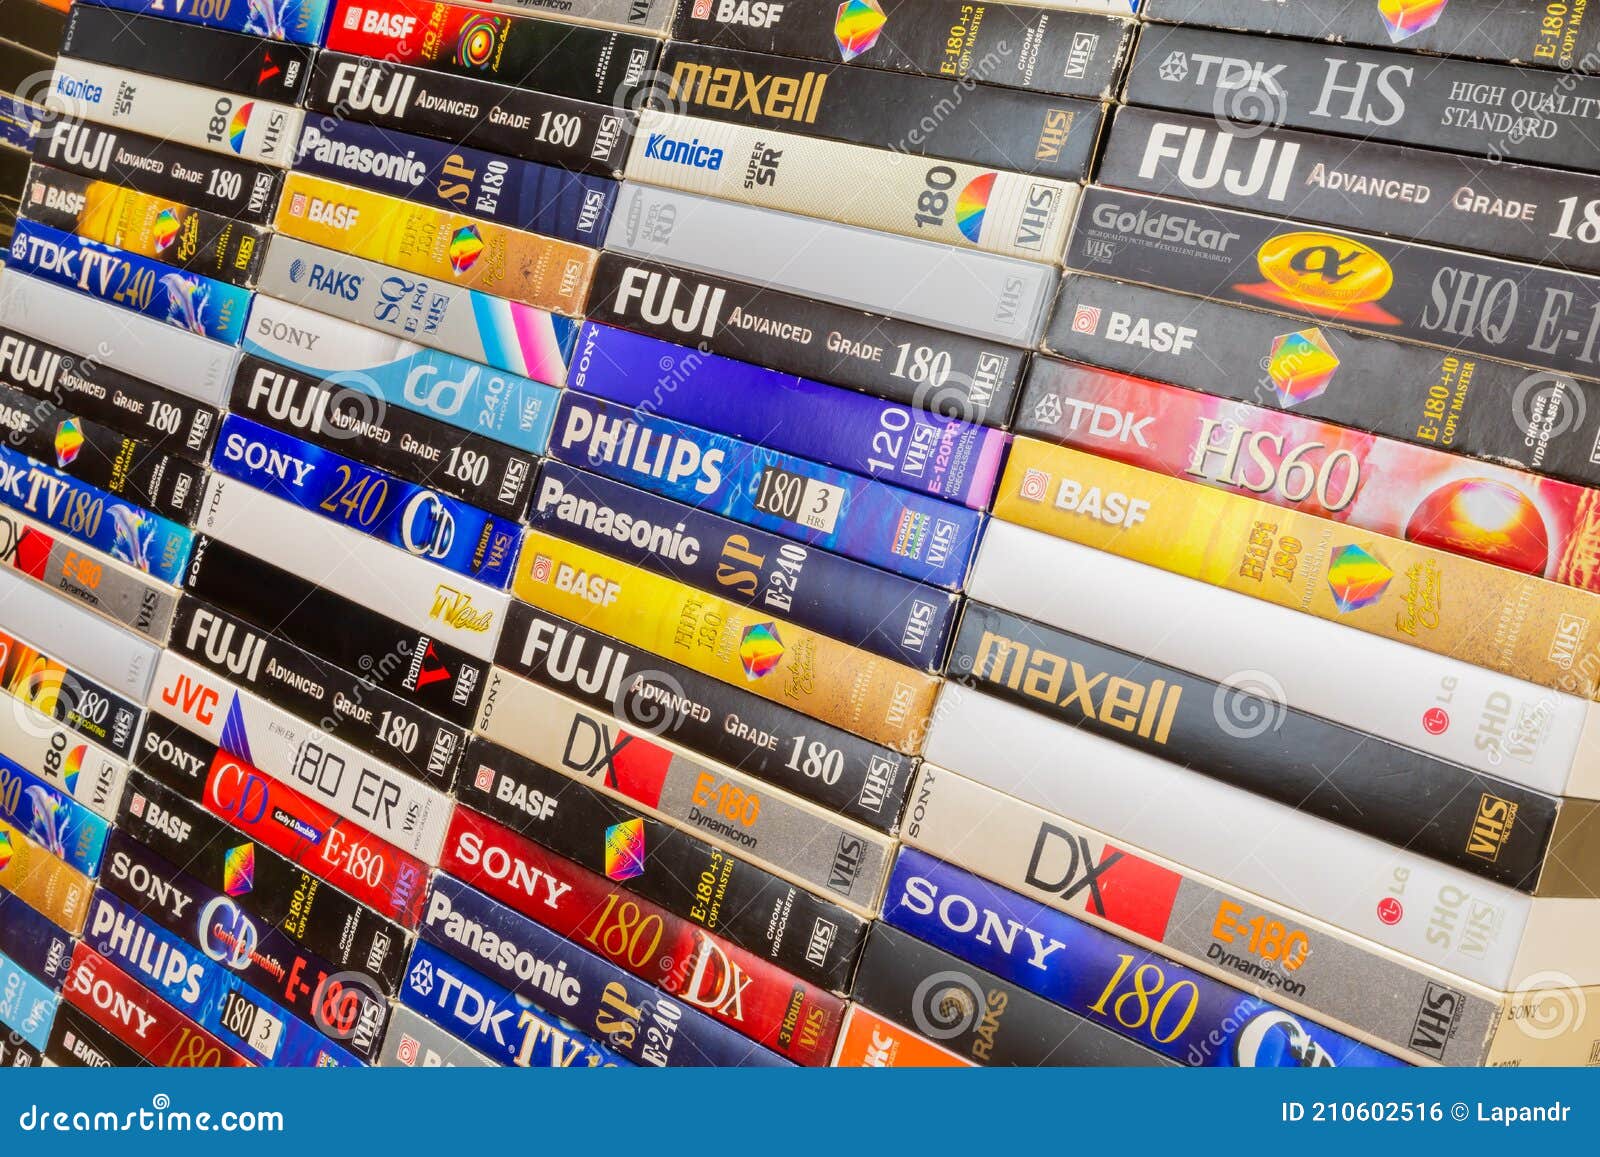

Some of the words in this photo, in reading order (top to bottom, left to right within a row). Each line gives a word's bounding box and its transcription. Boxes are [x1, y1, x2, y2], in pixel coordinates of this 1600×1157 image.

[363, 11, 417, 39] BASF
[715, 0, 784, 28] BASF
[965, 7, 985, 56] MASTER
[284, 62, 299, 87] VHS
[1017, 27, 1036, 72] CHROME
[1022, 14, 1049, 87] VIDEOCASSETTE
[57, 74, 102, 104] Konica
[121, 85, 136, 115] SR
[326, 61, 416, 118] FUJI
[414, 90, 480, 119] ADVANCED
[489, 105, 532, 130] GRADE
[534, 111, 581, 148] 180
[668, 61, 829, 124] maxell
[1190, 53, 1289, 97] TDK
[1309, 57, 1414, 126] HS
[1448, 81, 1507, 107] HIGH
[207, 97, 232, 144] 180
[1441, 107, 1558, 140] STANDARD
[48, 122, 116, 173] FUJI
[171, 163, 203, 184] GRADE
[207, 168, 241, 201] 180
[299, 125, 427, 187] Panasonic
[436, 153, 477, 206] SP
[644, 133, 724, 171] Konica
[744, 141, 765, 190] SUPER
[756, 148, 784, 187] SR
[1137, 122, 1301, 202] FUJI
[1305, 162, 1431, 205] ADVANCED
[1452, 185, 1538, 221] GRADE
[46, 183, 85, 215] BASF
[475, 160, 509, 215] E-180
[914, 165, 958, 228] 180
[308, 201, 360, 231] BASF
[1092, 202, 1240, 252] GoldStar
[28, 236, 77, 279] TDK
[236, 237, 252, 269] VHS
[308, 264, 363, 302] RAKS
[374, 276, 415, 324] SQ
[415, 282, 429, 312] 180
[1420, 266, 1519, 345] SHQ
[257, 317, 321, 352] SONY
[613, 265, 726, 338] FUJI
[727, 307, 813, 345] ADVANCED
[826, 331, 884, 362] GRADE
[889, 342, 951, 387] 180
[1105, 311, 1198, 355] BASF
[575, 325, 600, 388] SONY
[0, 335, 60, 393] FUJI
[112, 391, 144, 414] GRADE
[147, 400, 182, 434] 180
[478, 376, 506, 430] 240
[1442, 411, 1459, 445] COPY
[1455, 362, 1476, 410] MASTER
[246, 367, 331, 434] FUJI
[330, 408, 391, 444] ADVANCED
[400, 433, 441, 462] GRADE
[444, 446, 489, 487] 180
[867, 407, 910, 473] 120
[1525, 395, 1547, 447] CHROME
[1532, 381, 1566, 466] VIDEOCASSETTE
[561, 405, 726, 496] PHILIPS
[927, 421, 960, 493] E-120PR
[944, 429, 970, 493] PROFESSIONAL
[951, 429, 978, 497] VIDEOCASSETTE
[1064, 397, 1156, 449] TDK
[1184, 416, 1361, 513] HS60
[172, 475, 190, 508] VHS
[224, 433, 316, 487] SONY
[319, 464, 389, 526] 240
[756, 469, 800, 517] 180
[813, 489, 830, 514] 3
[1054, 478, 1151, 529] BASF
[537, 475, 700, 566] Panasonic
[806, 514, 826, 529] HRS
[189, 534, 208, 586] SONY
[487, 533, 508, 571] VHS
[716, 534, 766, 597] SP
[765, 543, 808, 613] E-240
[1271, 534, 1304, 584] 180
[137, 591, 157, 632] VHS
[555, 564, 623, 608] BASF
[186, 607, 268, 682] FUJI
[265, 657, 325, 701] ADVANCED
[333, 691, 373, 725] GRADE
[375, 710, 419, 755] 180
[402, 635, 430, 692] Premium
[971, 630, 1184, 745] maxell
[72, 689, 110, 724] 180
[162, 674, 219, 726] JVC
[480, 673, 501, 732] SONY
[520, 617, 630, 702] FUJI
[628, 674, 712, 724] ADVANCED
[724, 713, 780, 752] GRADE
[784, 735, 844, 786] 180
[43, 732, 67, 778] 180
[113, 710, 133, 748] VHS
[144, 732, 206, 778] SONY
[561, 712, 633, 790] DX
[145, 803, 192, 844] BASF
[352, 768, 401, 829] ER
[496, 774, 558, 822] BASF
[691, 771, 761, 827] E-180
[908, 768, 936, 839] SONY
[688, 806, 758, 849] Dynamicron
[110, 852, 193, 918] SONY
[321, 827, 384, 888] E-180
[1024, 821, 1126, 918] DX
[1388, 866, 1411, 896] LG
[708, 904, 721, 929] COPY
[716, 858, 735, 902] MASTER
[766, 897, 784, 940] CHROME
[1425, 884, 1470, 950] SHQ
[340, 914, 352, 950] CHROME
[341, 906, 363, 965] VIDEOCASSETTE
[425, 890, 581, 1007] Panasonic
[455, 832, 572, 910] SONY
[584, 893, 664, 968] 180
[678, 930, 753, 1022] DX
[771, 887, 796, 958] VIDEOCASSETTE
[1211, 899, 1310, 972] E-180
[45, 939, 63, 977] VHS
[91, 899, 204, 1005] PHILIPS
[367, 932, 387, 973] VHS
[900, 876, 1067, 972] SONY
[1087, 954, 1200, 1044] 180
[1206, 943, 1307, 997] Dynamicron
[73, 966, 157, 1039] SONY
[221, 992, 255, 1037] 180
[284, 955, 359, 1035] E-180
[435, 968, 515, 1047] TDK
[595, 981, 642, 1049] SP
[1408, 984, 1460, 1059] VHS
[259, 1019, 272, 1040] 3
[641, 1000, 682, 1067] E-240
[971, 988, 1010, 1061] RAKS
